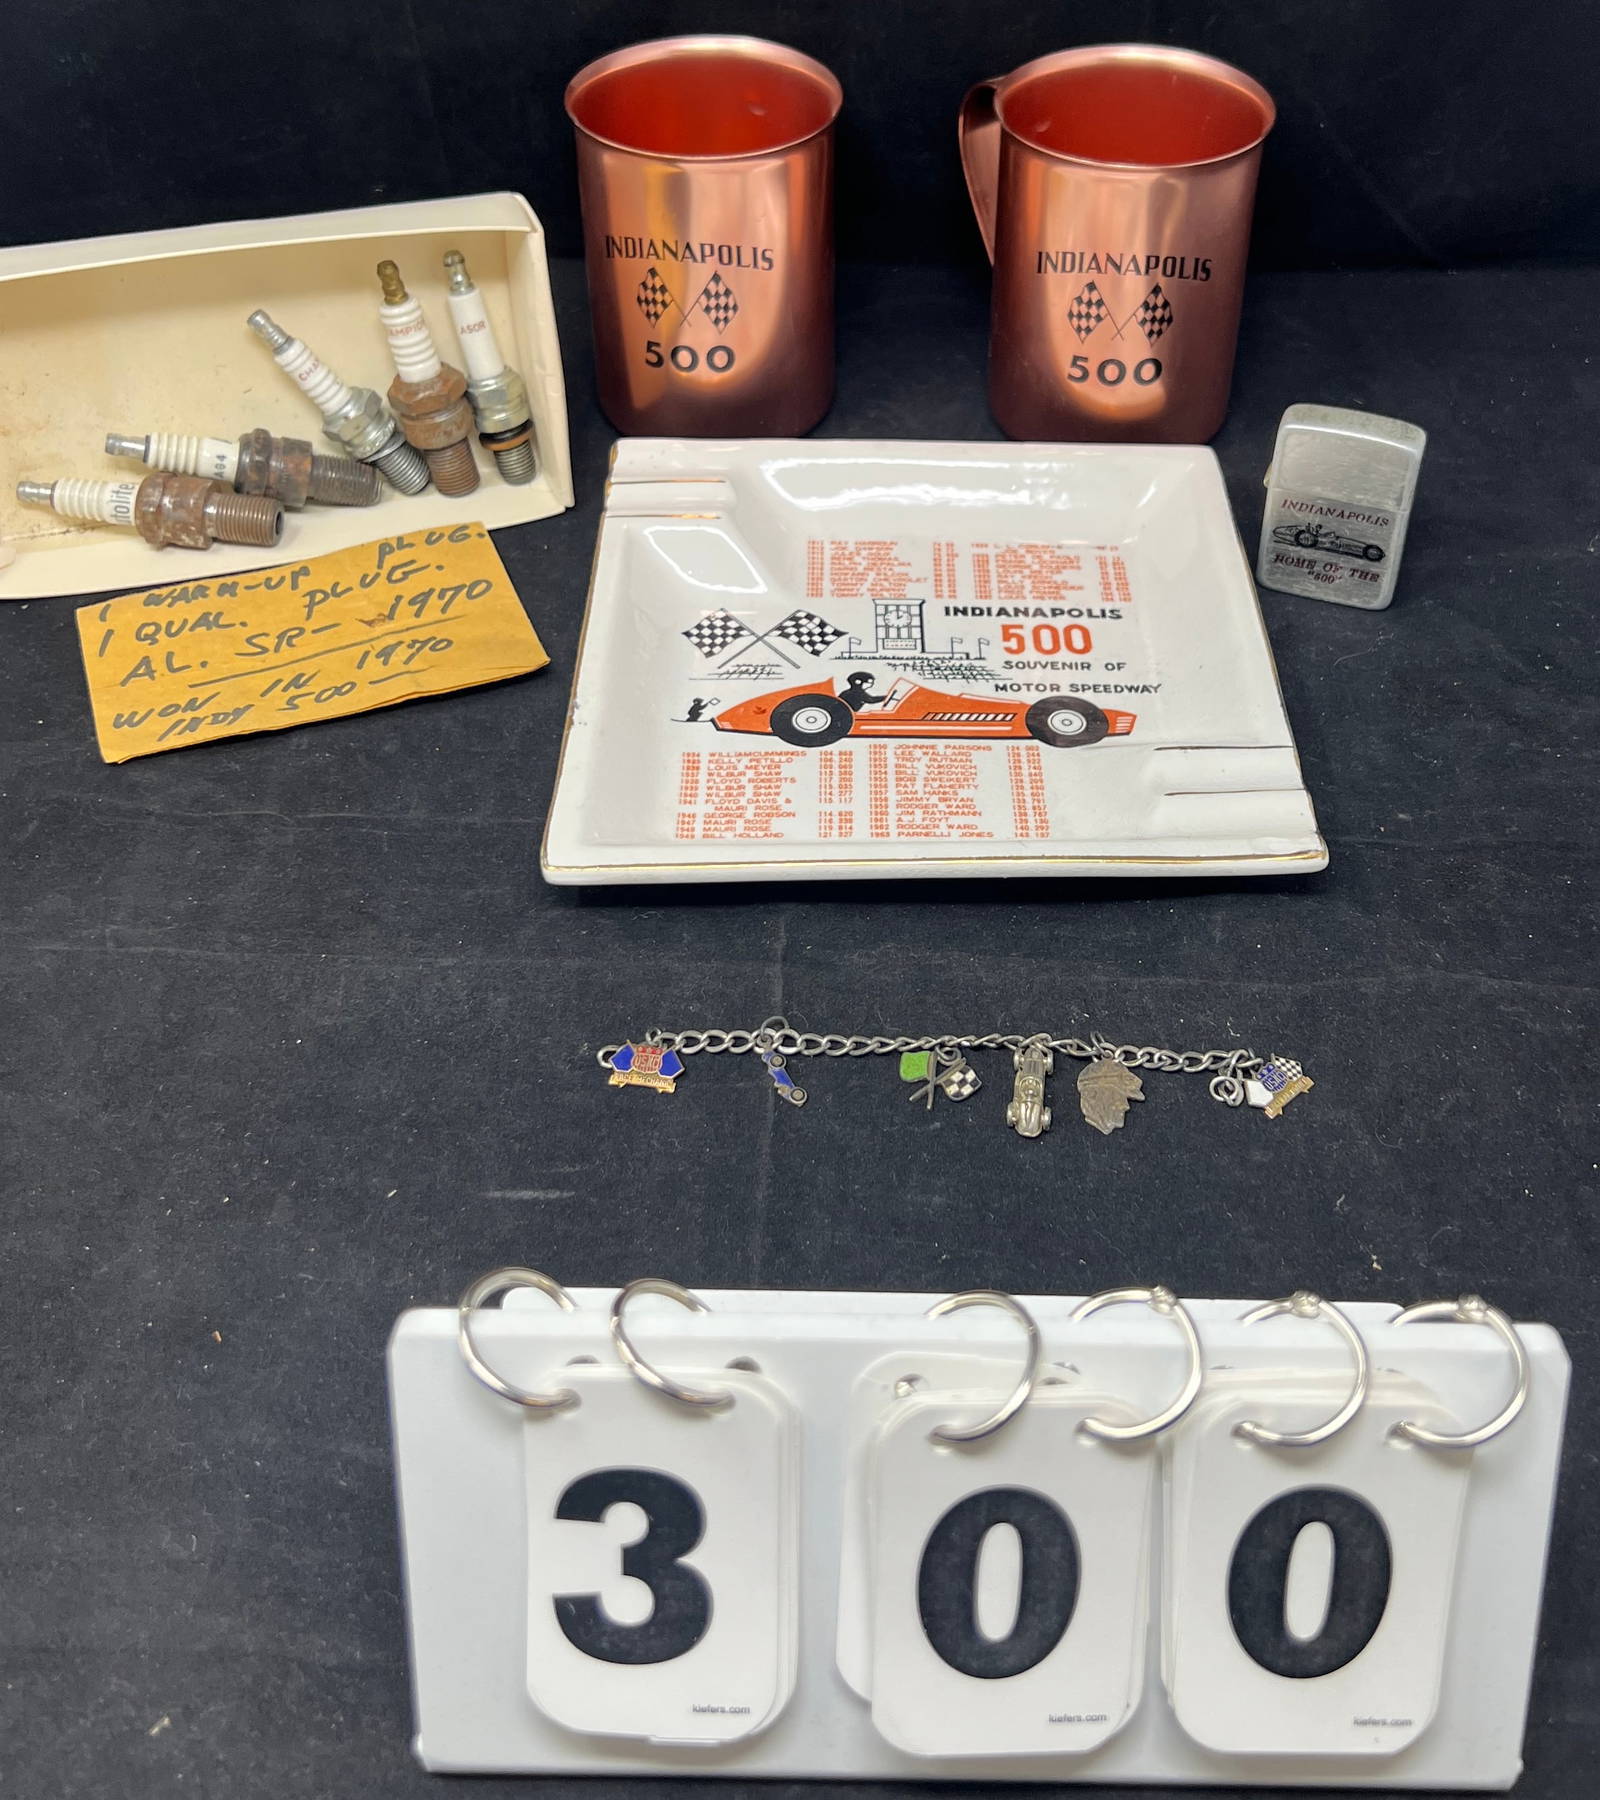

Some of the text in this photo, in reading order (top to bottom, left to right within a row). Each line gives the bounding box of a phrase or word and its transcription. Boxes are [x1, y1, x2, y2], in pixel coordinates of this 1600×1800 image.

[604, 235, 774, 271] INDIANAPOLIS
[1036, 251, 1214, 282] INDIANAPOLIS
[644, 340, 736, 373] 500
[1067, 354, 1163, 387] 500
[1280, 499, 1390, 527] INDIANAPOLIS
[1272, 552, 1380, 583] HOME OF THE
[387, 579, 493, 620] 1970
[944, 606, 1123, 621] INDIANAPOLIS
[135, 611, 248, 645] QUAL.
[1000, 623, 1093, 655] 500
[356, 637, 454, 670] 1970
[1002, 660, 1128, 672] SOUVENIR OF
[994, 683, 1162, 694] MOTOR SPEEDWAY
[551, 1467, 1392, 1680] 3 0 0
[692, 1704, 751, 1714] kiefers.com
[1048, 1712, 1107, 1723] kiefers.com
[1353, 1715, 1412, 1727] kiefers.com
